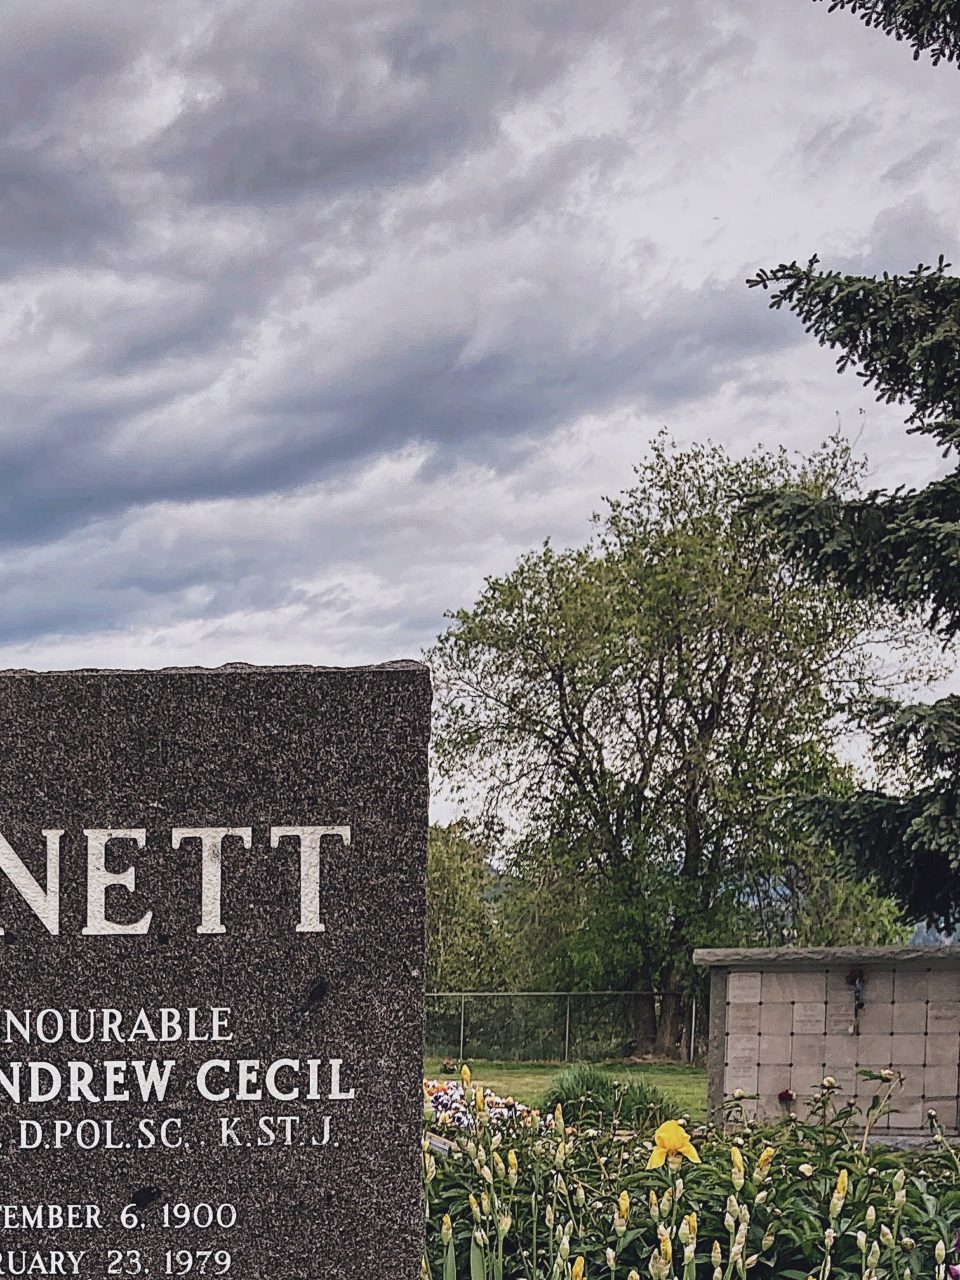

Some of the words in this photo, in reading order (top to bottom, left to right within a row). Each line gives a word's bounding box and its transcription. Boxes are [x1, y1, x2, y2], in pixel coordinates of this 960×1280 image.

[196, 1058, 355, 1102] CECIL
[120, 1204, 147, 1229] 6,
[163, 1203, 237, 1228] 1900
[108, 1250, 150, 1274] 23,
[165, 1250, 231, 1275] 1979
